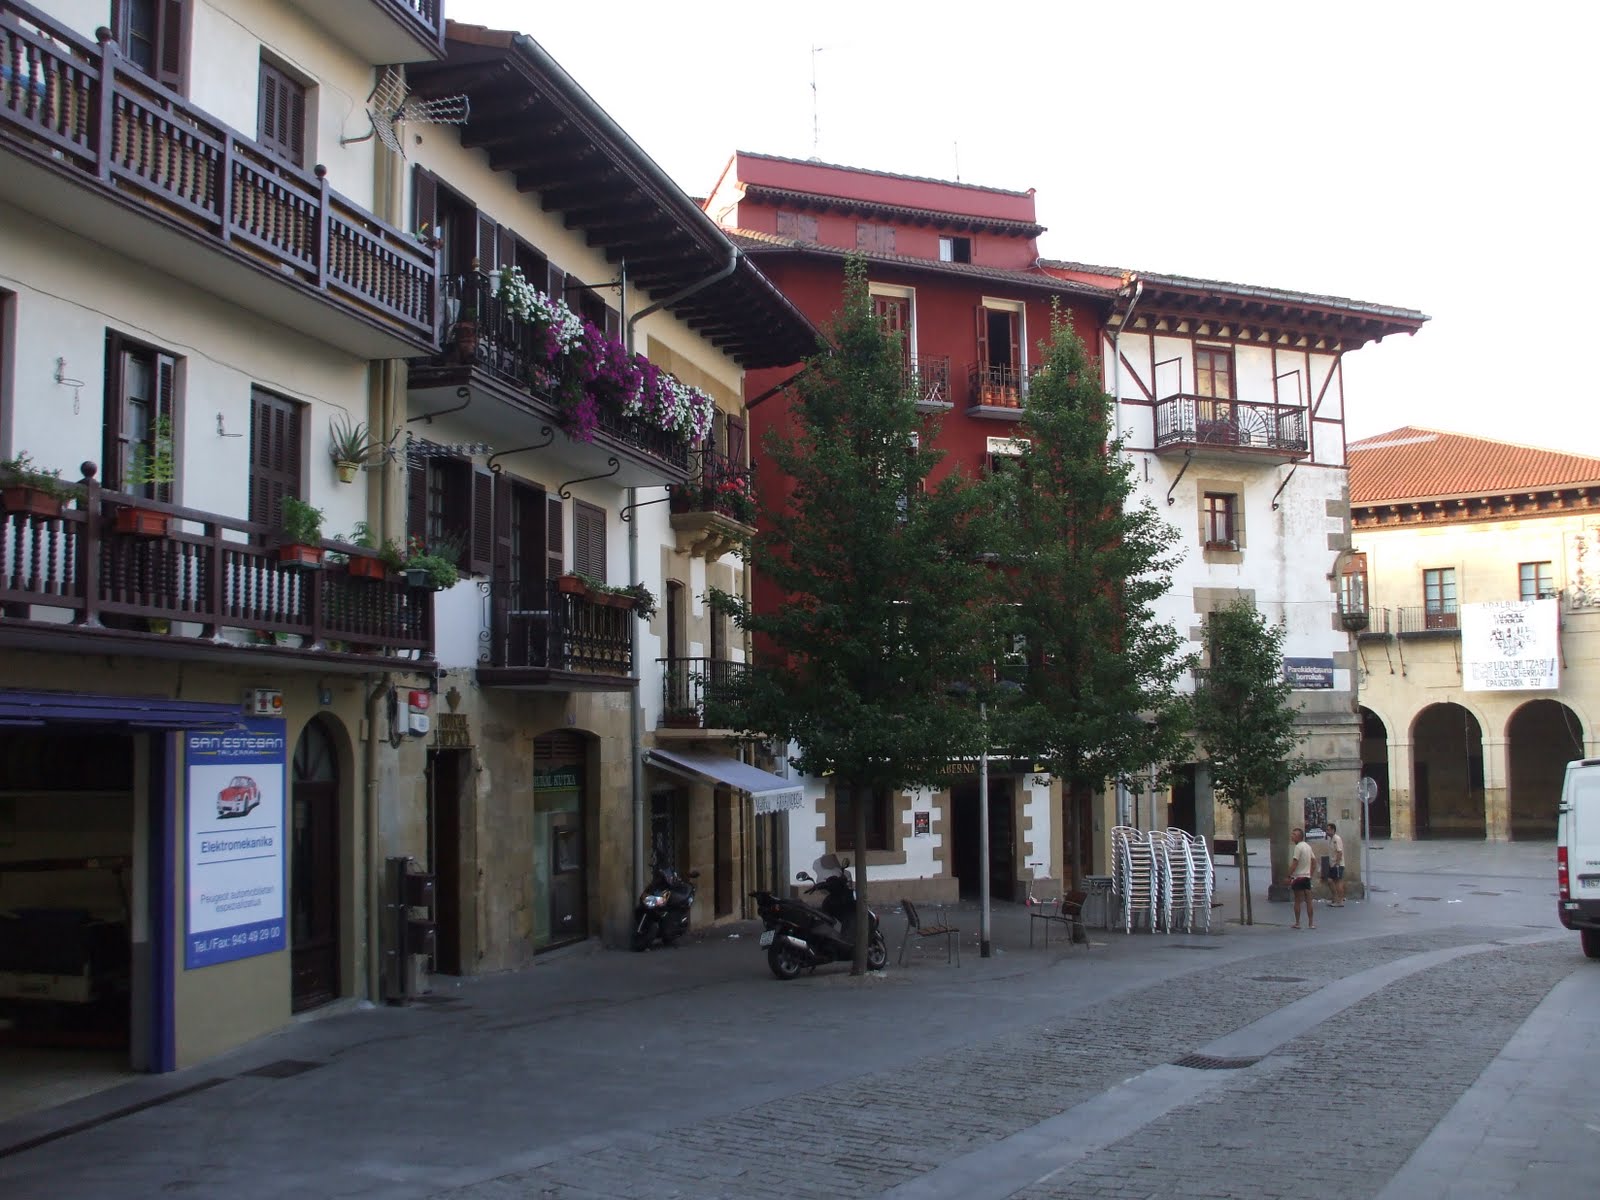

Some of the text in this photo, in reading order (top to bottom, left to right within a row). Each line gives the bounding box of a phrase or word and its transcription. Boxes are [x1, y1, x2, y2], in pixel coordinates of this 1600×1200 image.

[190, 737, 283, 748] SAN ESTEBAN
[201, 837, 273, 853] Elektromekanika
[200, 893, 229, 904] Peugeot
[232, 932, 247, 946] 943
[259, 928, 269, 940] 29
[270, 926, 280, 938] 00
